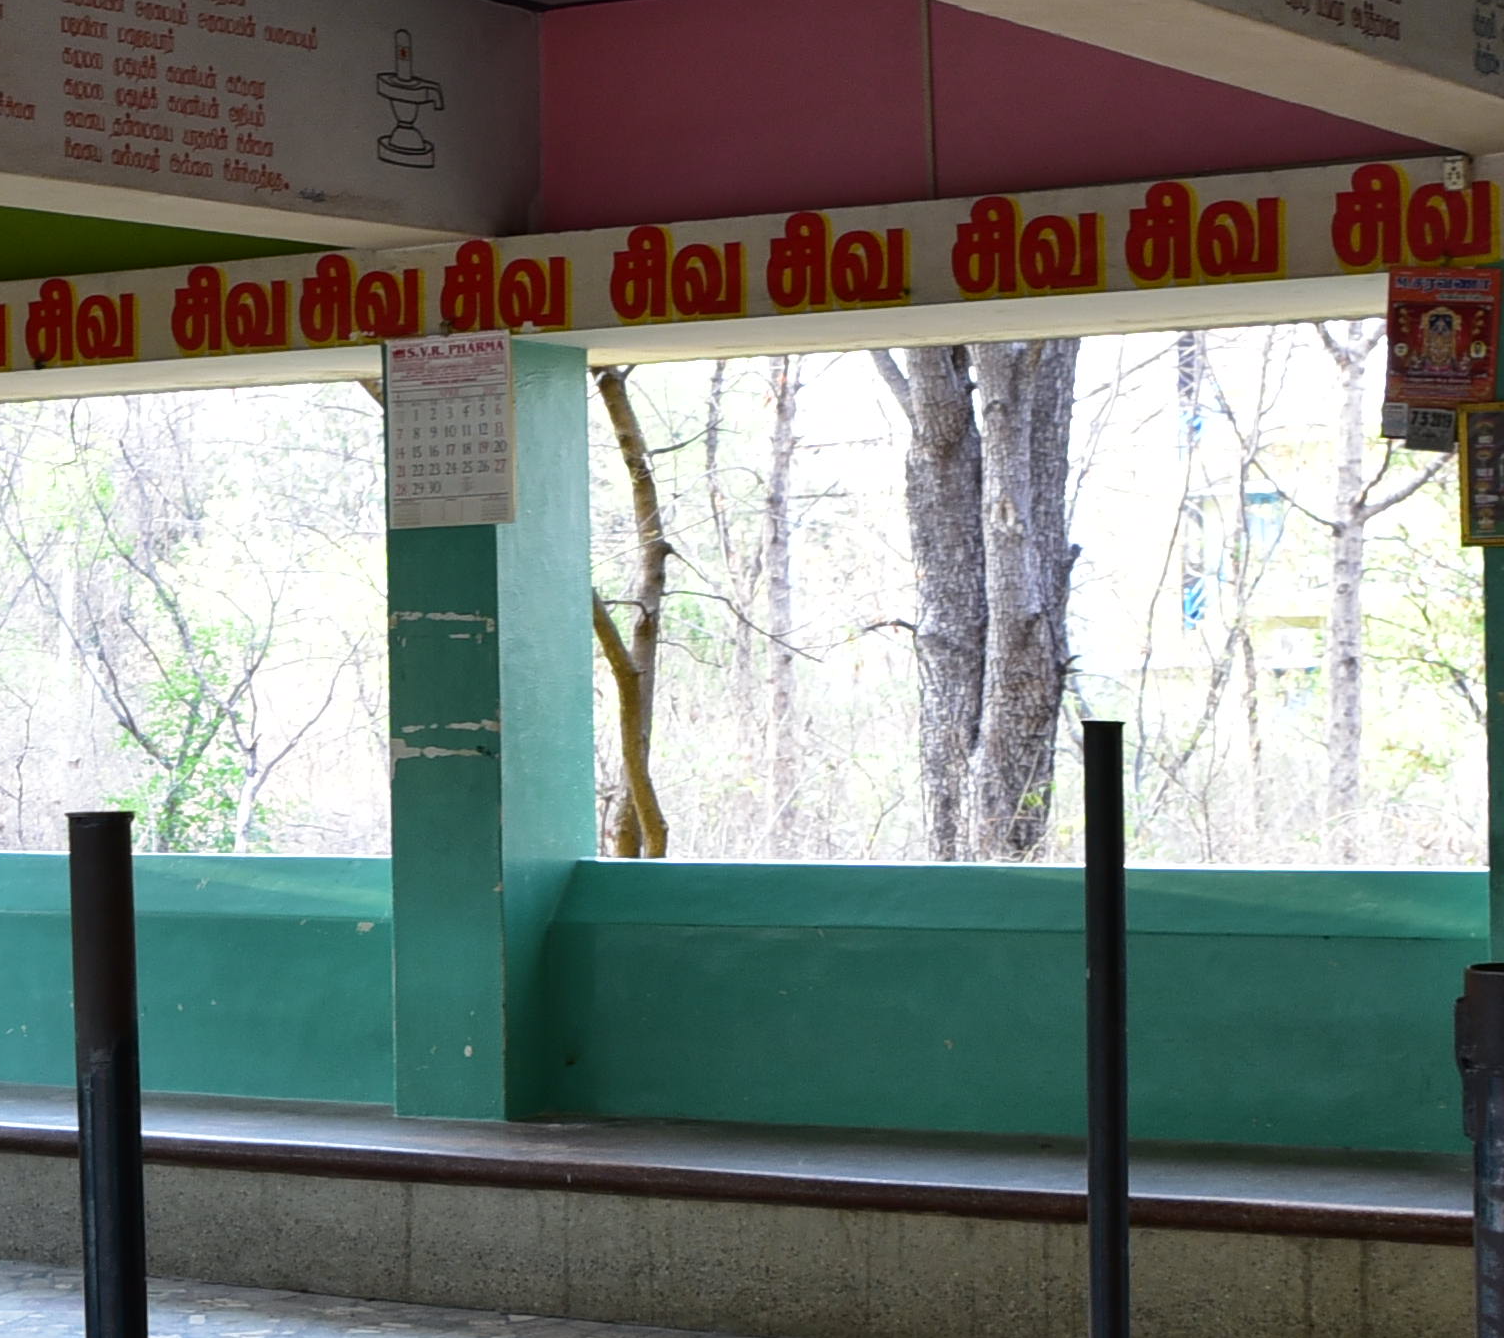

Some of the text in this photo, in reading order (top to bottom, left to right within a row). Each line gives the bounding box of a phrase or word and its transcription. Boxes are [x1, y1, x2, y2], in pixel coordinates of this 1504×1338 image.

[27, 280, 135, 360] சிவ
[173, 267, 287, 351] சிவ
[302, 255, 420, 343] சிவ
[443, 240, 567, 330] சிவ
[611, 226, 743, 317] சிவ
[768, 212, 905, 306] சிவ
[953, 197, 1097, 292] சிவ
[1126, 182, 1279, 281] சிவ
[1334, 164, 1492, 266] சிவ
[407, 341, 504, 357] S.V.R. PHARMA
